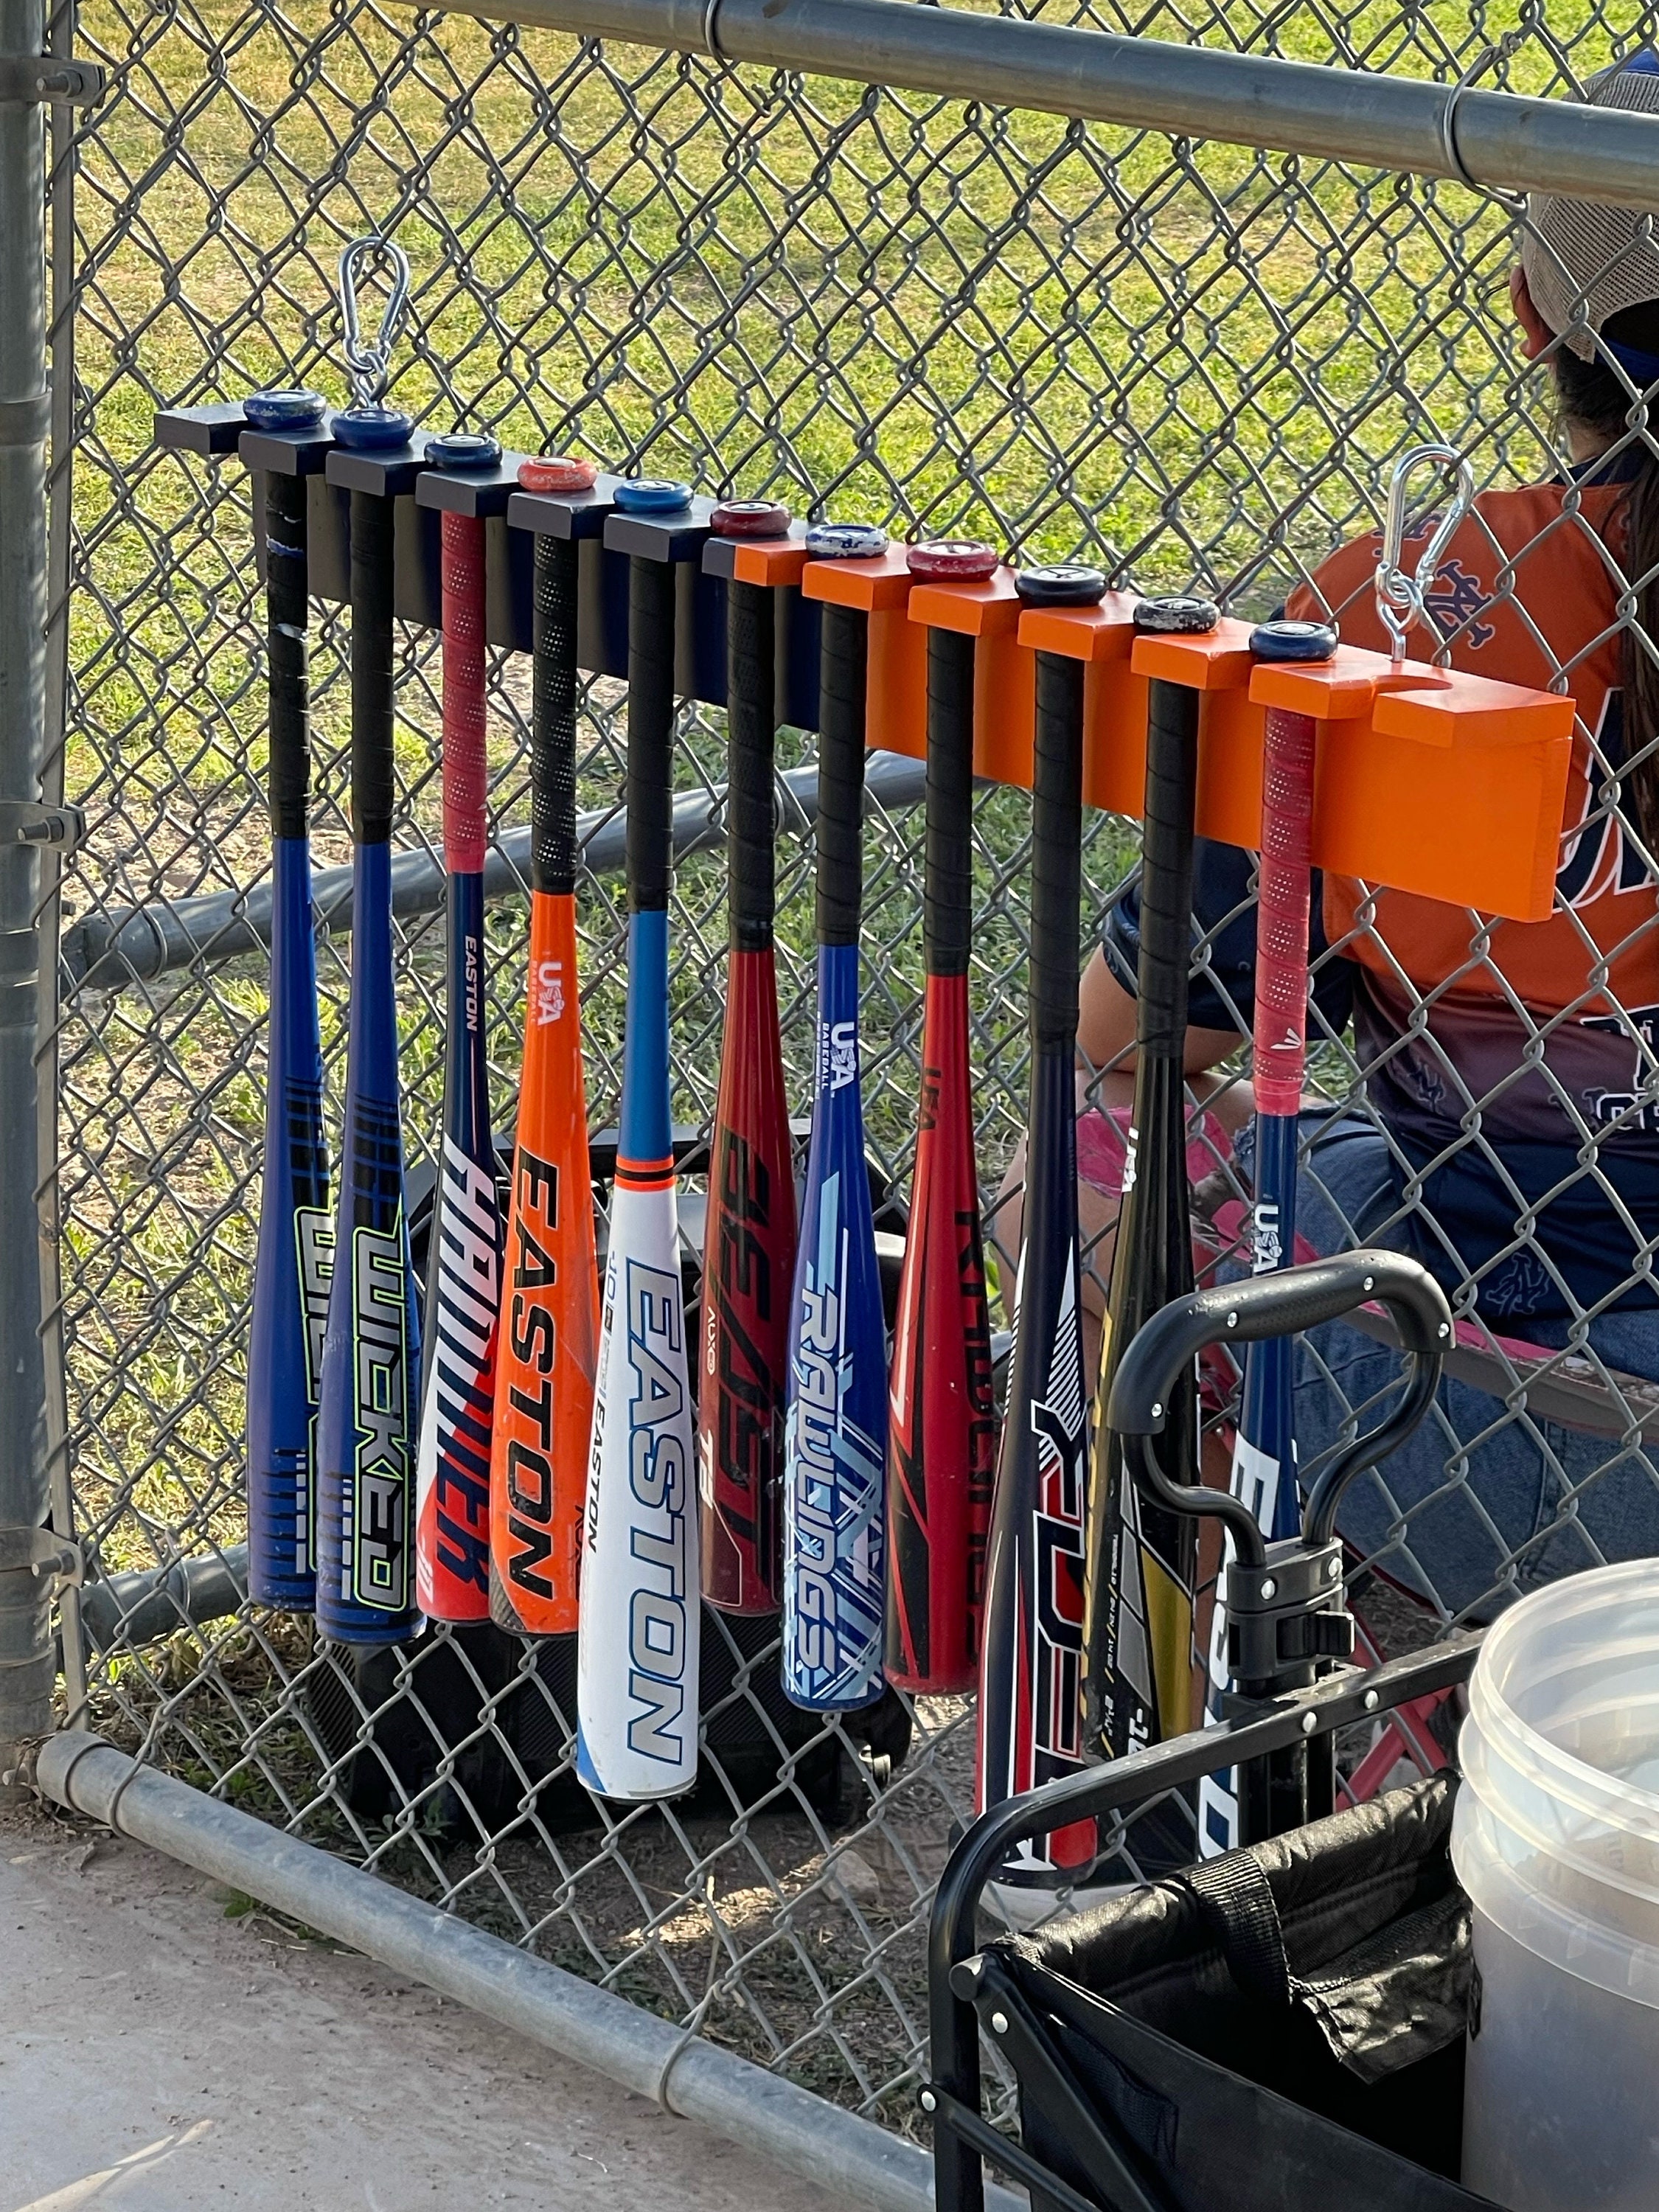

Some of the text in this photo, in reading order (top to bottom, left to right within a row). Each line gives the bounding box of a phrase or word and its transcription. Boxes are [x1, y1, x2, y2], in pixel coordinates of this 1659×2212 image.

[465, 935, 478, 1032] EASTON
[538, 961, 565, 1026] USA
[821, 1022, 830, 1091] BASEBALL
[830, 1021, 857, 1091] USA
[352, 1227, 407, 1613] WICKED
[437, 1133, 498, 1595] HAMMER
[507, 1145, 559, 1600] EASTON
[588, 1398, 605, 1553] EASTON
[626, 1258, 685, 1766] EASTON
[717, 1124, 771, 1590] BEAST
[796, 1289, 840, 1673] RAWLINGS
